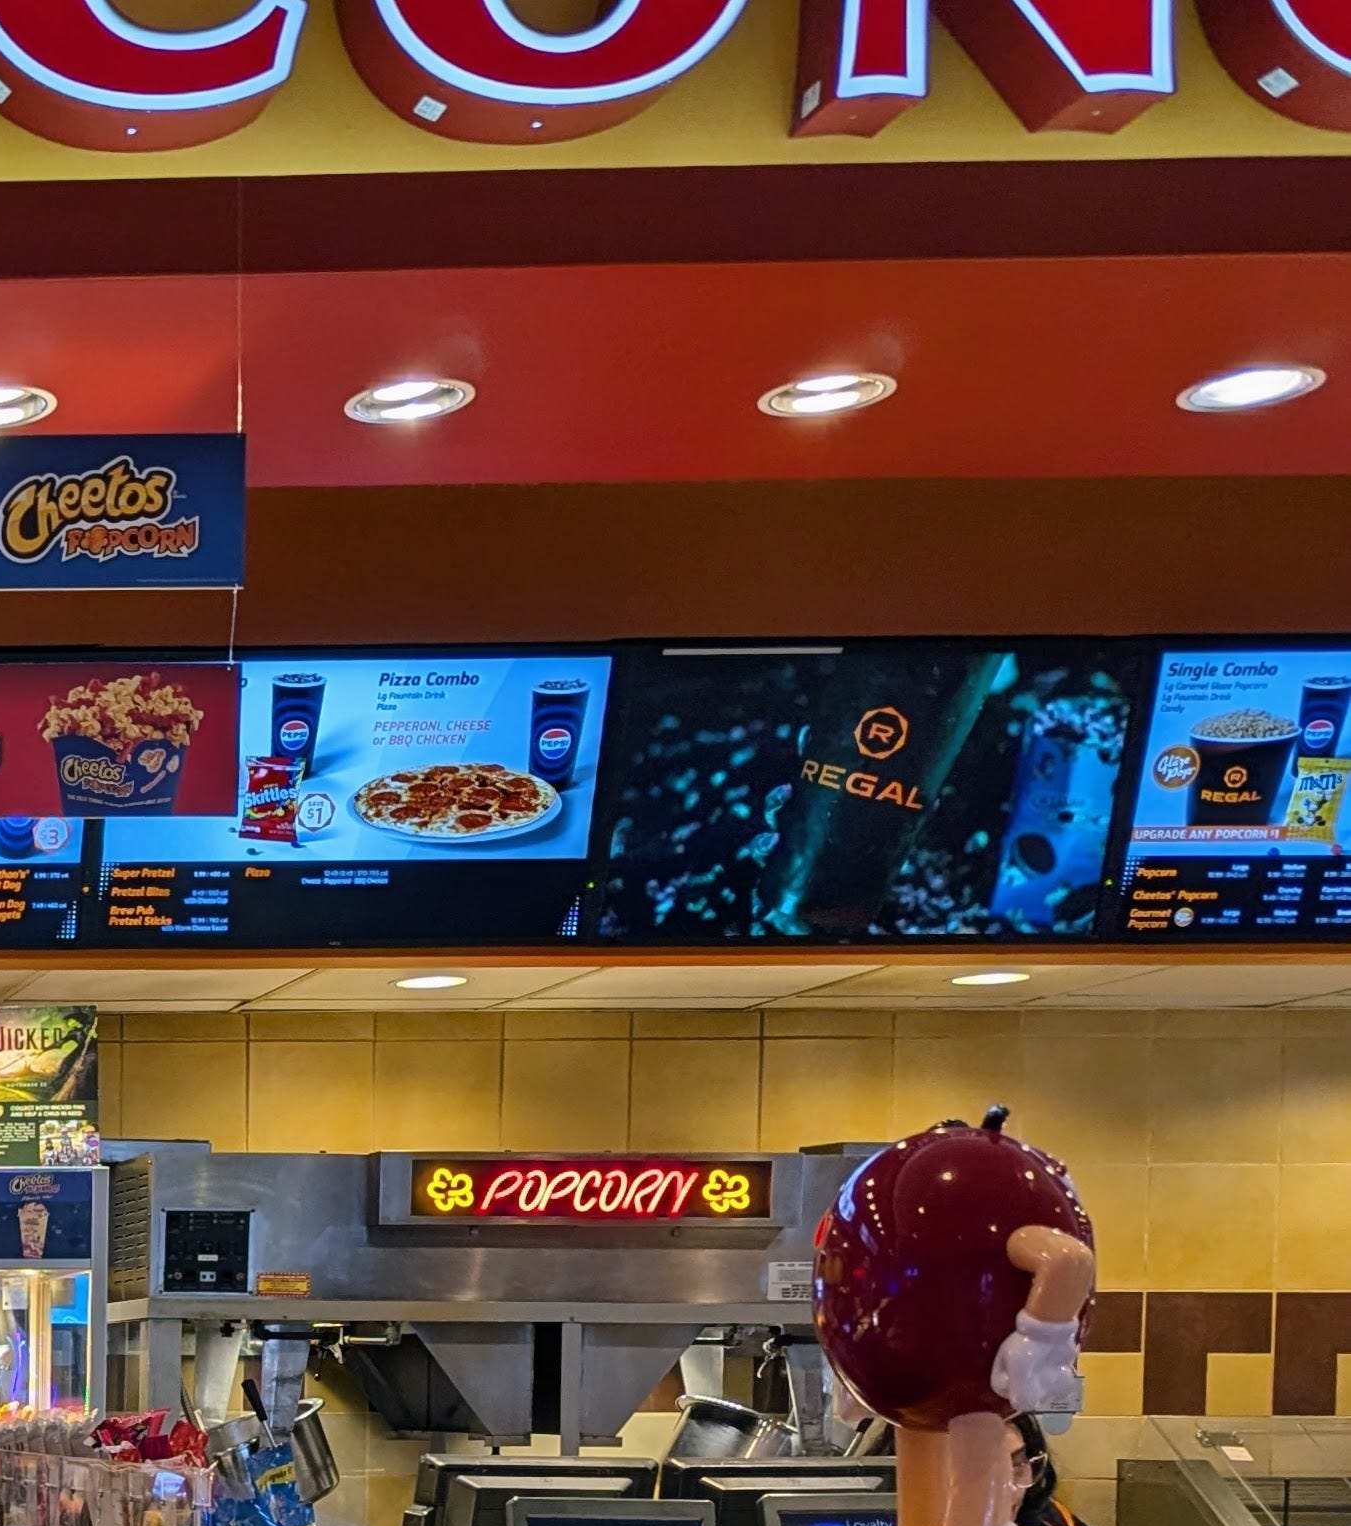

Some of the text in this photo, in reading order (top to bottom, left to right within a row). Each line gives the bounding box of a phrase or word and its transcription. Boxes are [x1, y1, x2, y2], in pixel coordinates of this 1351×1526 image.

[0, 457, 173, 563] Cheetos
[64, 520, 198, 556] POPCORN
[379, 672, 479, 687] Pizza Combo
[1168, 662, 1278, 681] Single Combo
[447, 720, 491, 731] CHEESE
[389, 734, 466, 747] BBQ CHICKEN
[65, 759, 123, 783] Cheetos
[801, 760, 924, 810] REGAL
[244, 786, 298, 807] Skittles
[1200, 790, 1261, 803] REGAL
[307, 808, 322, 824] $1
[1134, 829, 1267, 840] UPGRADE ANY POPCORN
[11, 1173, 52, 1194] Cheetos
[481, 1169, 698, 1214] POPCORN
